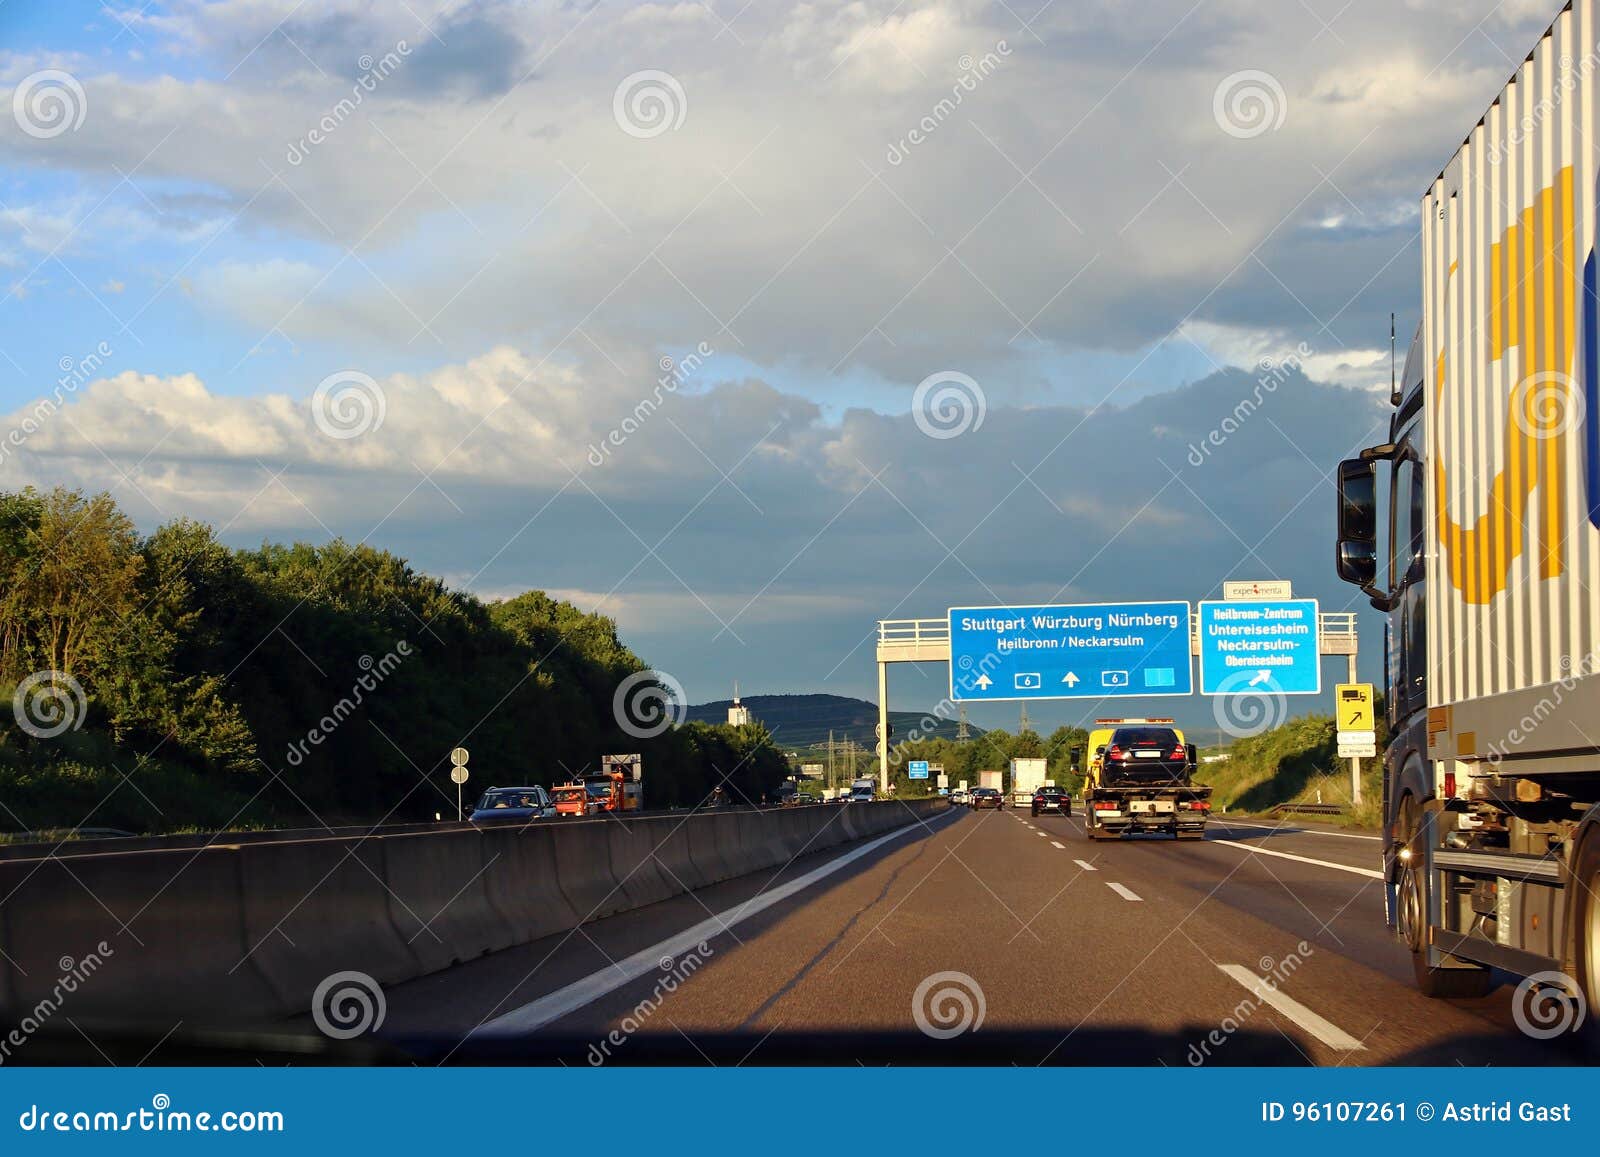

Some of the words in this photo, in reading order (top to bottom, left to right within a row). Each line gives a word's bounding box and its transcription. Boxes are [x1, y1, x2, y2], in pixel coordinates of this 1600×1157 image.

[1213, 607, 1303, 621] Heilbronn-Zentrum
[961, 617, 1026, 634] Stuttgart
[1032, 615, 1103, 631] Würzburg
[1108, 612, 1178, 629] Nürnberg
[1208, 622, 1309, 636] Untereisesheim
[997, 637, 1059, 649] Heilbronn
[1068, 634, 1144, 648] Neckarsulm
[1217, 638, 1301, 652] Neckarsulm-
[1225, 653, 1294, 667] Obereisesheim
[1023, 676, 1032, 687] 6
[1110, 674, 1119, 684] 6
